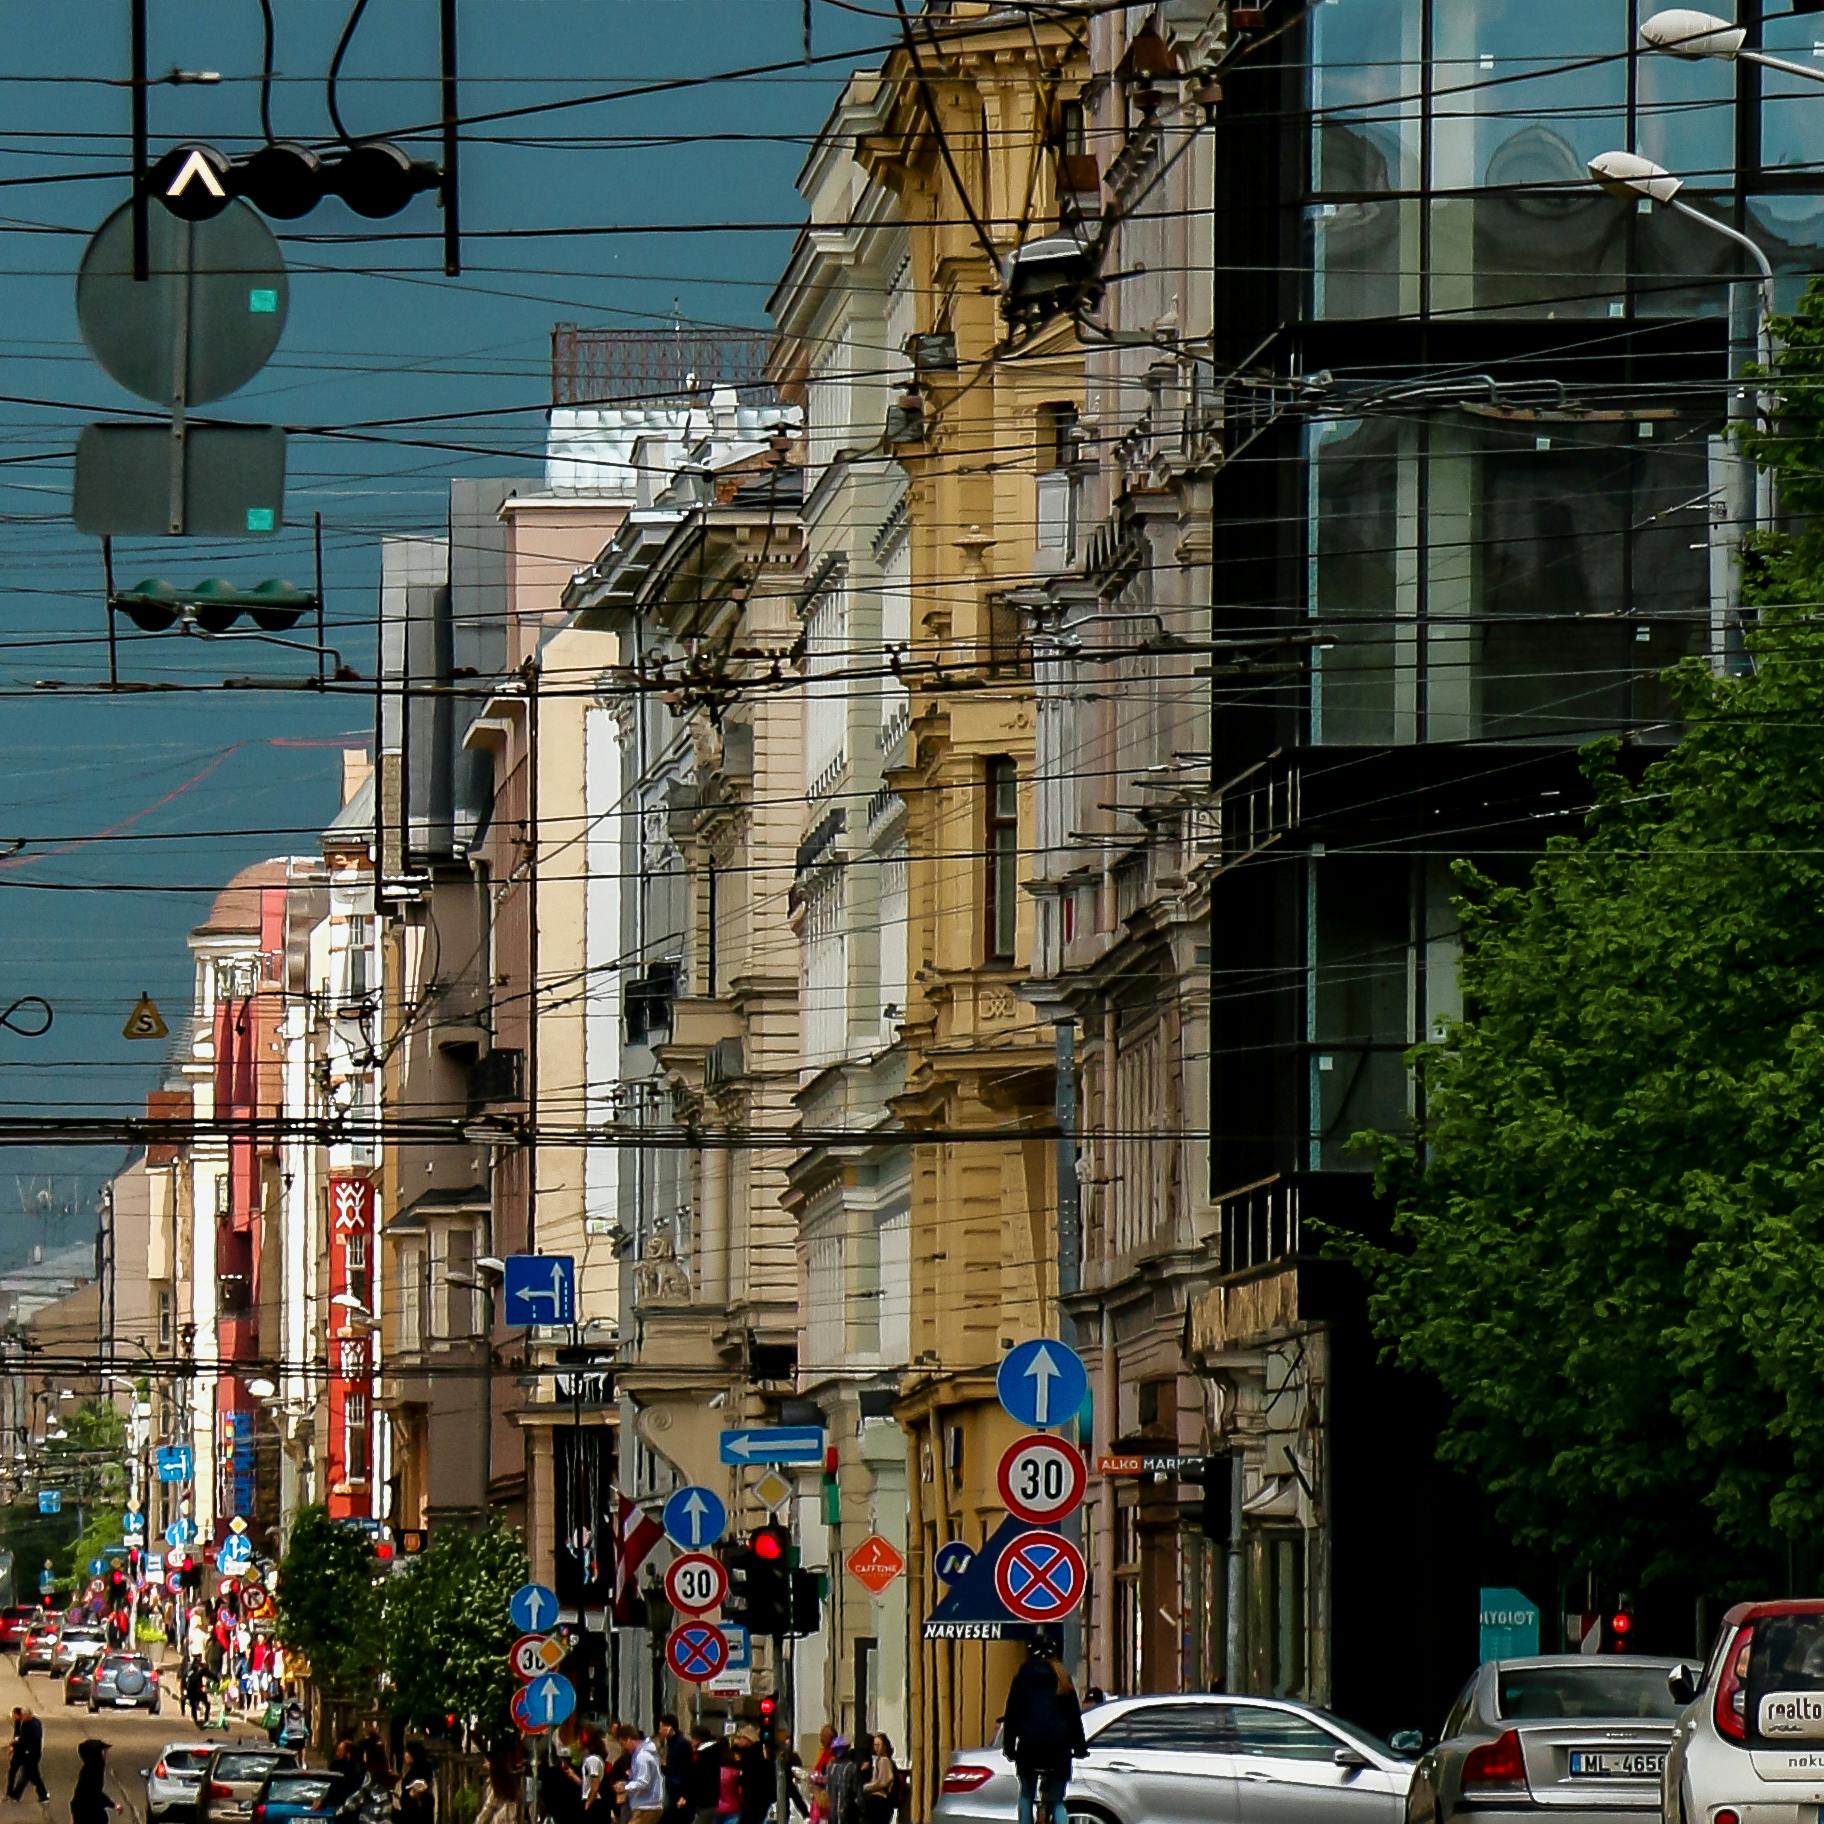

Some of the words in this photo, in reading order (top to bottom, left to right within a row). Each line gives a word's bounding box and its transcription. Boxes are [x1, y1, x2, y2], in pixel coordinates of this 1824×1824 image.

[137, 1014, 153, 1032] S
[1102, 1458, 1138, 1470] ALKO
[1143, 1458, 1203, 1470] MARK
[1021, 1458, 1063, 1500] 30
[682, 1569, 711, 1598] 30
[924, 1623, 1002, 1639] NARVESEN
[1768, 1697, 1822, 1720] realto
